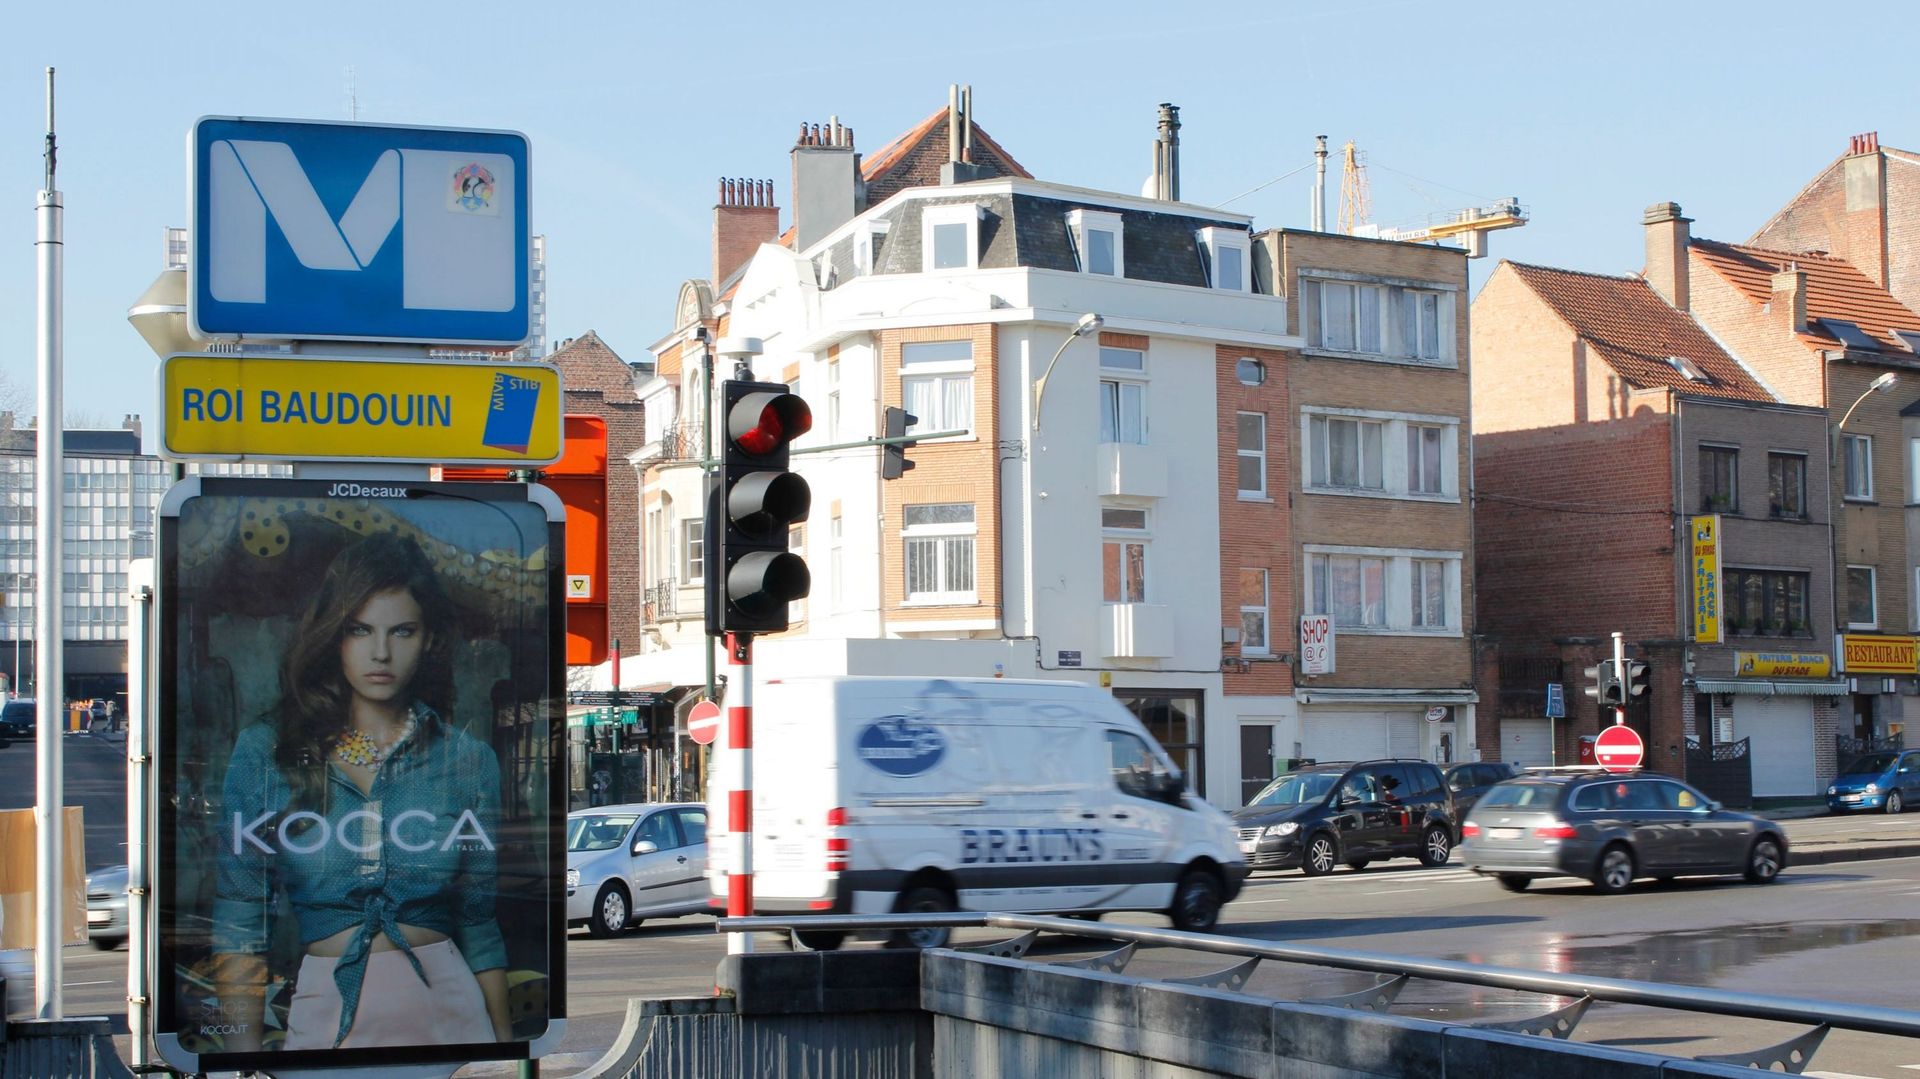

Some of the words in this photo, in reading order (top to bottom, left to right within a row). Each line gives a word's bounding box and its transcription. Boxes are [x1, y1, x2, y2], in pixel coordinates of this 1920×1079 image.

[510, 378, 538, 390] STIB
[493, 375, 504, 411] MIVB
[182, 388, 243, 422] ROI
[260, 390, 451, 427] BAUDOUIN
[328, 483, 407, 498] JCDecaux
[1303, 619, 1328, 644] SHOP
[1758, 654, 1793, 663] FRITERIE
[1846, 645, 1914, 664] RESTAURANT
[1772, 666, 1785, 675] DU
[1784, 666, 1811, 675] STADE
[233, 809, 496, 855] KOCCA
[200, 1001, 248, 1016] SHOP
